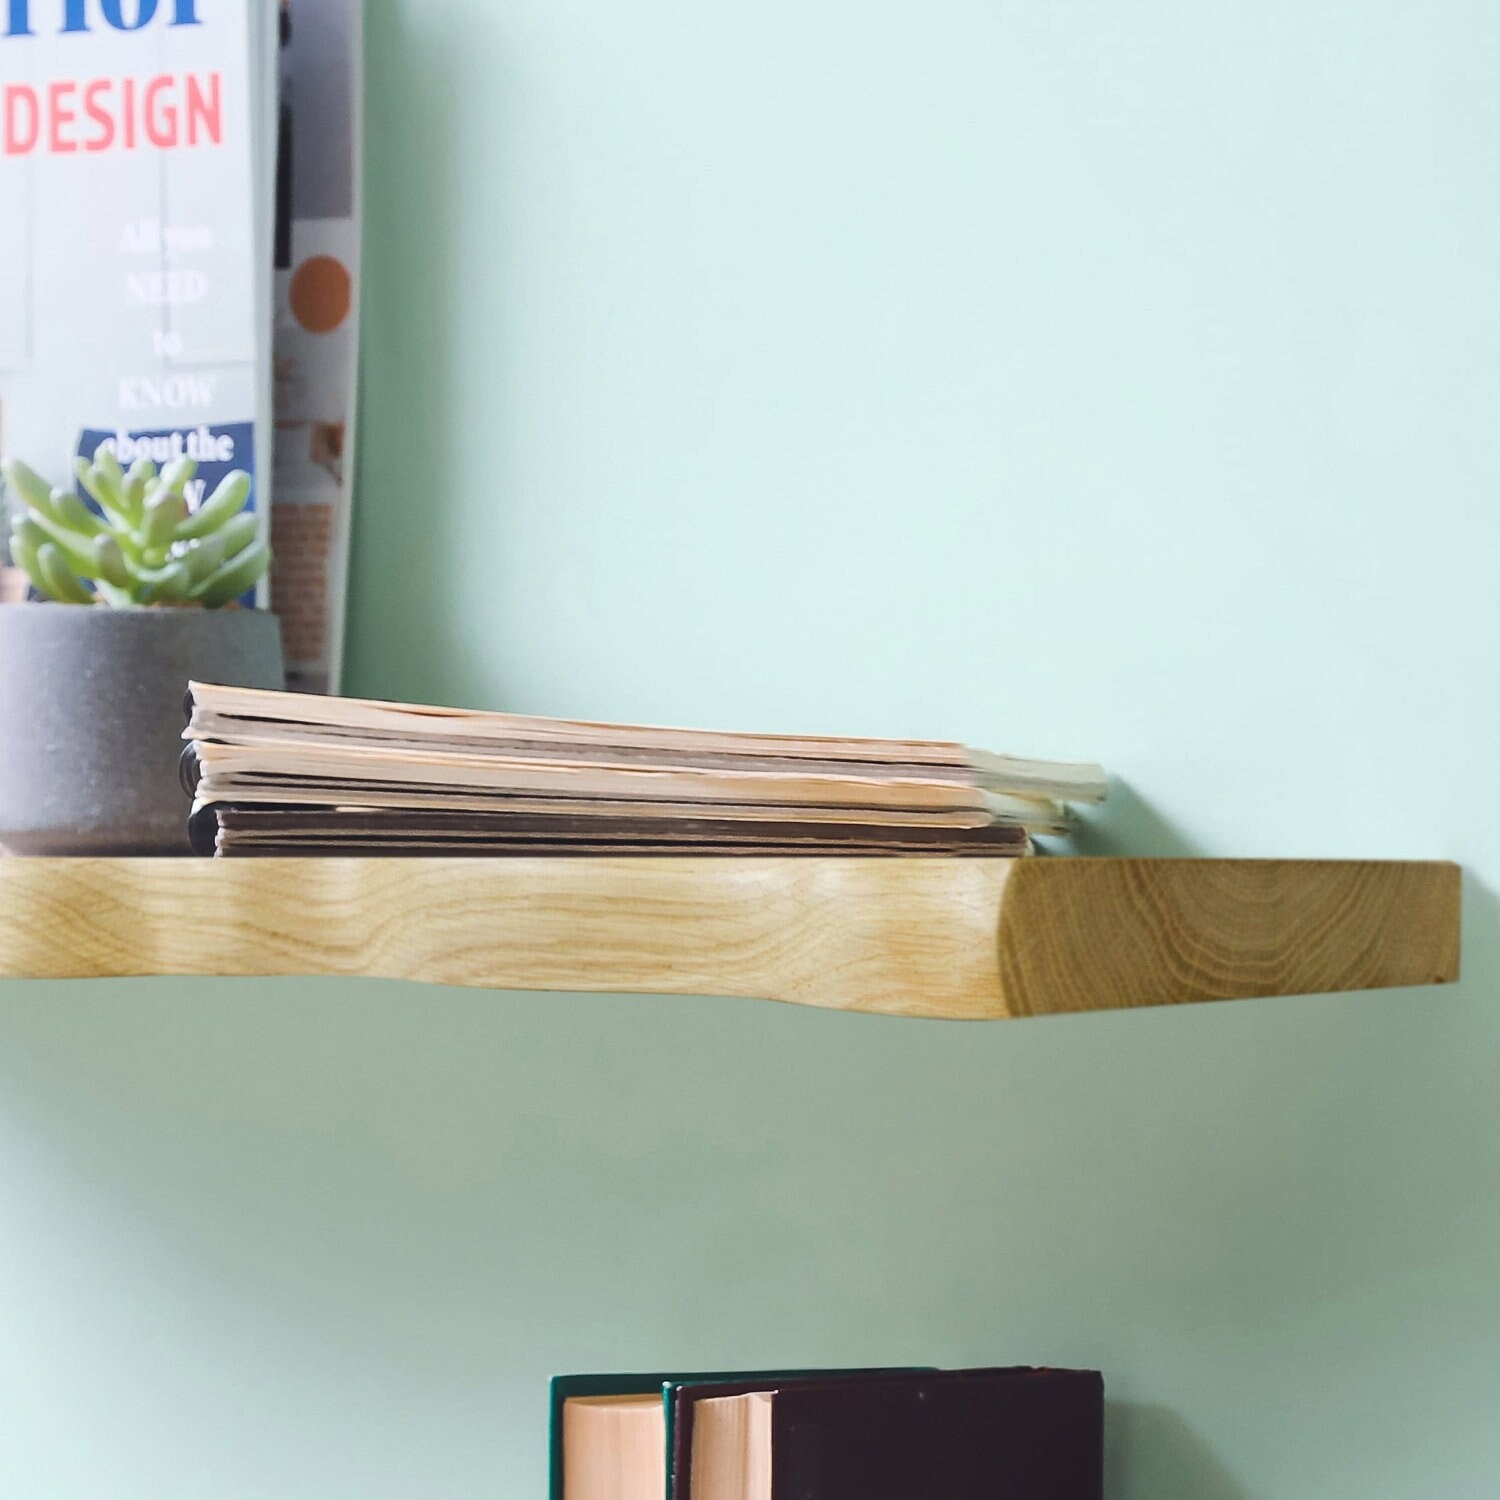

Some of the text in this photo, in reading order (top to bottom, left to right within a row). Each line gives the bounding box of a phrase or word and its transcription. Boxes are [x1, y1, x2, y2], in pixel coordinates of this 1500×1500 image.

[4, 72, 223, 156] DESIGN
[126, 271, 208, 304] NEED
[118, 375, 215, 410] KNOW
[187, 425, 235, 462] the
